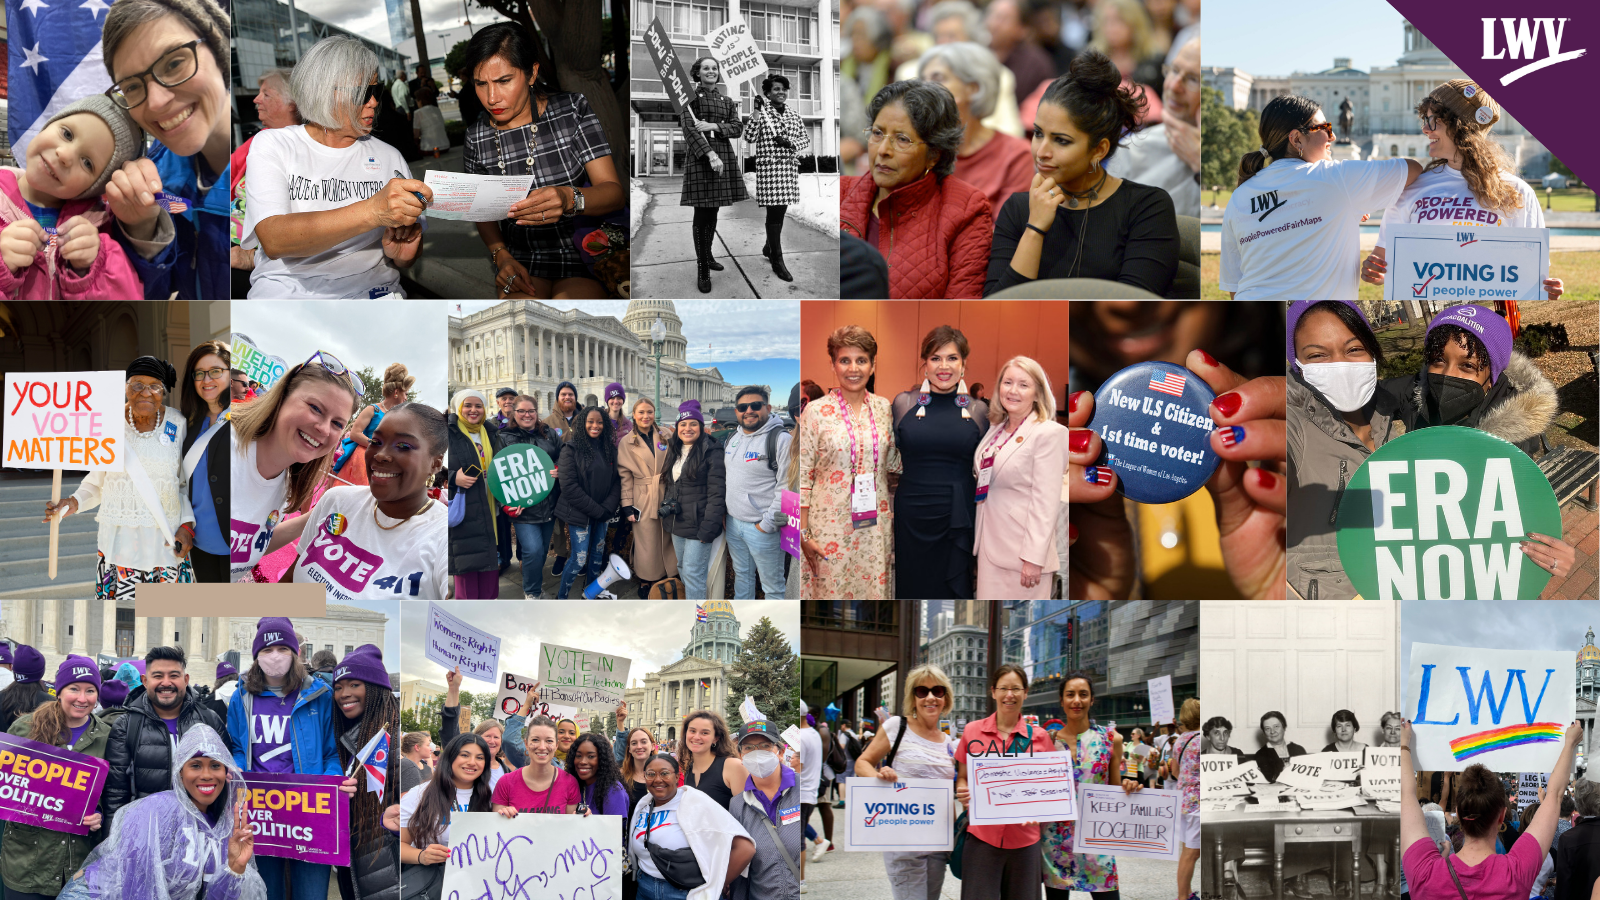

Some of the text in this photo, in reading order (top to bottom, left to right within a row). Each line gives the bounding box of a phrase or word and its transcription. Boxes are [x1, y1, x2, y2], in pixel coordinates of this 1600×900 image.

[647, 25, 667, 60] VOTE
[711, 24, 746, 50] VOTING
[727, 42, 736, 51] IS
[660, 49, 675, 78] BABY
[720, 46, 756, 69] PEOPLE
[726, 56, 760, 79] POWER
[668, 69, 689, 107] VOTE
[289, 174, 383, 202] AGUE OF WOMEN VOTERS
[1251, 190, 1280, 216] LWV
[1414, 197, 1474, 213] PEOPLE
[1417, 208, 1499, 225] POWERED
[1456, 232, 1476, 243] LWV
[1413, 262, 1519, 283] VOTING IS
[1432, 286, 1518, 298] people power
[232, 338, 285, 378] WEHO
[11, 380, 93, 416] YOUR
[1108, 388, 1214, 431] New U.S Citizen
[32, 411, 103, 437] VOTE
[1151, 421, 1162, 435] &
[7, 436, 116, 466] MATTERS
[1100, 425, 1205, 466] 1st time voter!
[493, 448, 544, 482] ERA
[500, 470, 549, 504] NOW
[1368, 457, 1525, 541] ERA
[314, 529, 424, 597] VOTE 411
[1375, 542, 1525, 600] NOW
[263, 632, 282, 643] LWV
[450, 641, 465, 653] are
[468, 636, 497, 657] Rights
[433, 639, 493, 673] Human Rights
[544, 646, 614, 672] VOTE IN
[72, 667, 91, 676] LWV
[548, 670, 576, 685] Local
[1412, 664, 1556, 726] LWV
[252, 714, 292, 744] LW
[0, 750, 91, 792] PEOPLE
[1291, 763, 1322, 778] VOTE
[1371, 754, 1401, 767] VOT
[0, 785, 65, 812] OLITICS
[236, 788, 331, 814] PEOPLE
[864, 802, 935, 816] VOTING IS
[1090, 800, 1174, 819] KEEP FAMILIES
[248, 821, 314, 842] OLITICS
[878, 818, 908, 826] people
[1087, 820, 1168, 842] TOGETHER
